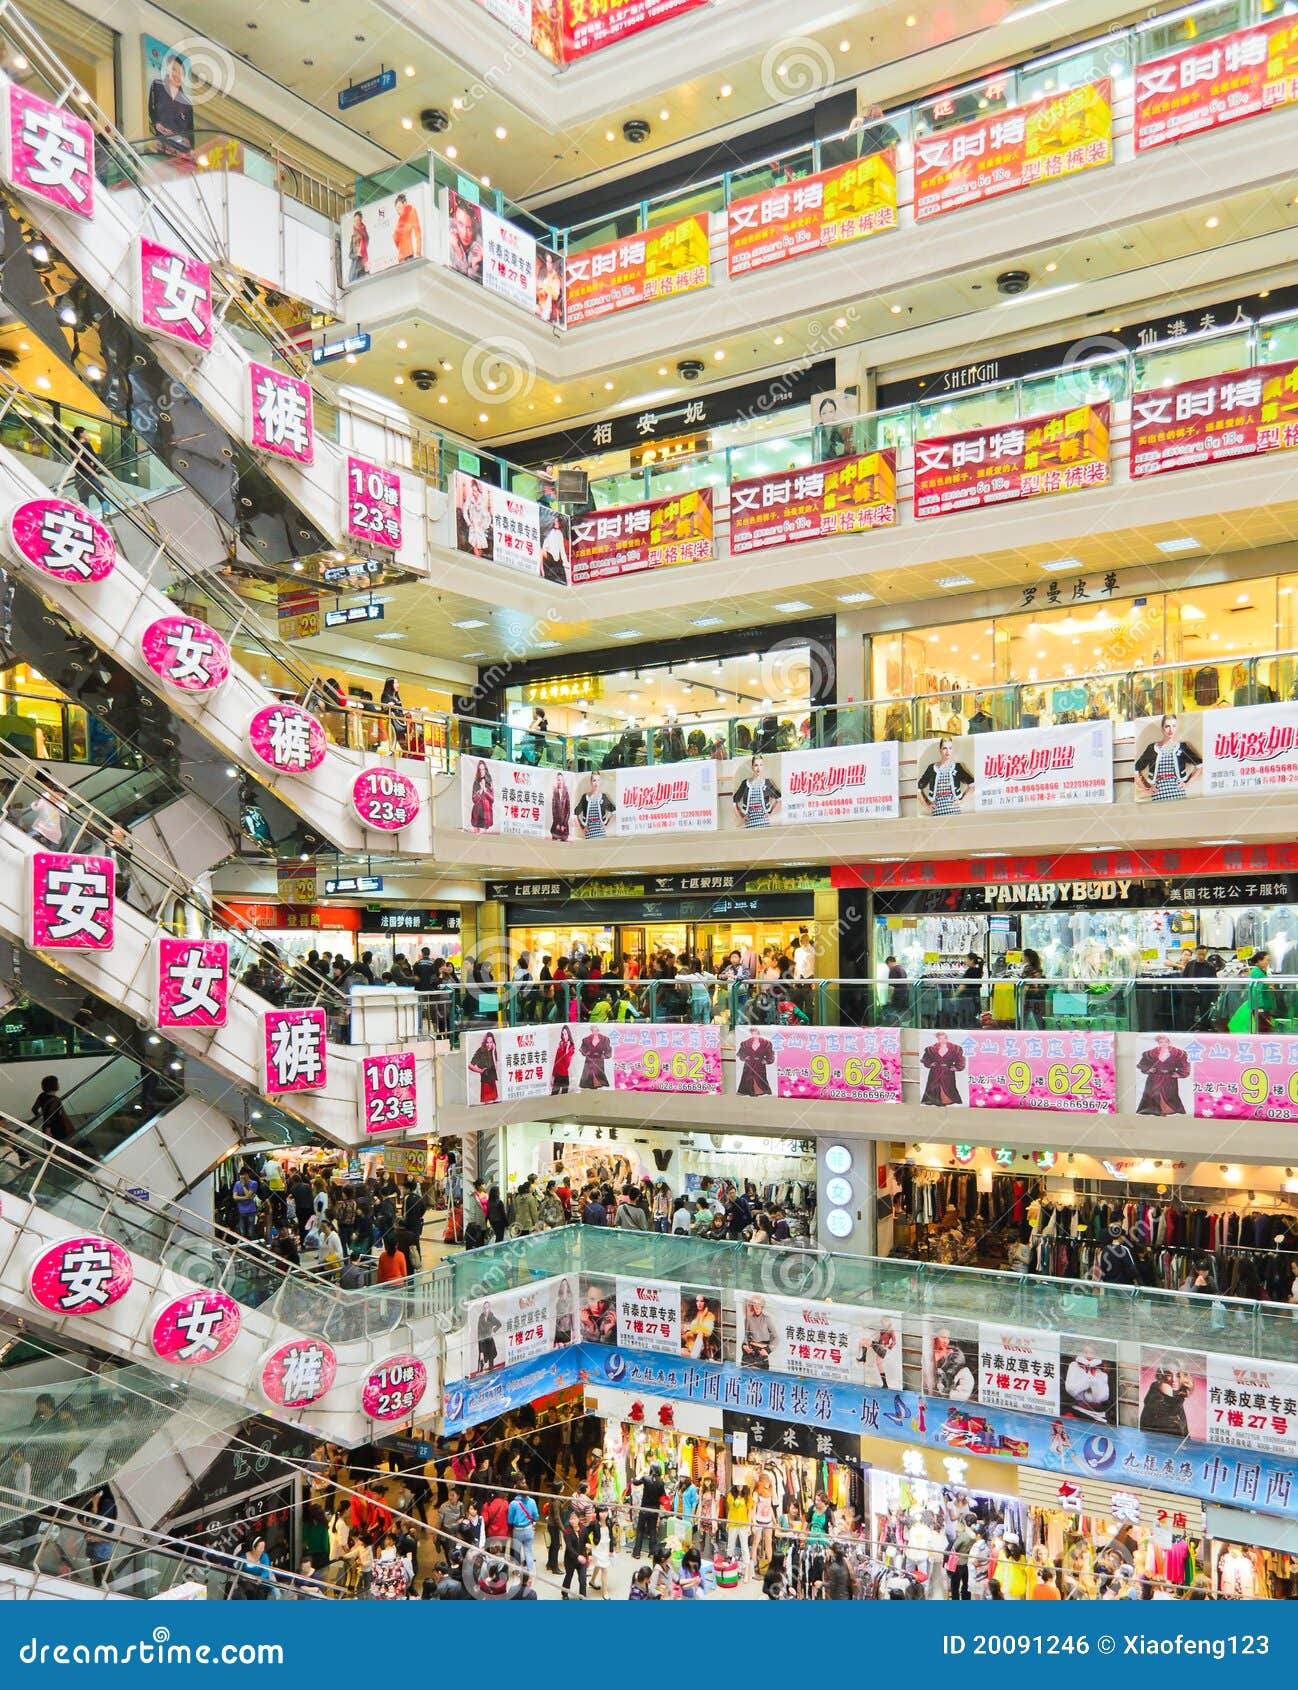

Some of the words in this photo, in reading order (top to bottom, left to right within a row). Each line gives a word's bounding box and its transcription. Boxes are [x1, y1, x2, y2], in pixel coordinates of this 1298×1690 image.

[1137, 34, 1268, 104] 文时特
[23, 108, 88, 203] 安
[915, 115, 1025, 175] 文时特
[1021, 139, 1108, 184] 型格裤装
[729, 182, 823, 235] 文时特
[820, 206, 894, 245] 型格裤装
[490, 259, 527, 289] 7楼27号
[565, 241, 645, 287] 文时特
[152, 257, 206, 336] 女
[643, 265, 707, 300] 型格裤装
[258, 378, 310, 454] 裤
[1132, 378, 1262, 430] 文时特
[916, 429, 1025, 475] 文时特
[351, 467, 400, 507] 10楼
[732, 473, 824, 514] 文时特
[1020, 461, 1106, 497] 型格裤装
[351, 501, 401, 540] 23号
[571, 509, 650, 546] 文时特
[820, 503, 894, 535] 型格裤装
[41, 510, 96, 578] 安
[496, 532, 534, 556] 7楼27号
[648, 538, 712, 568] 型格裤装
[1020, 572, 1120, 608] 罗曼皮草
[167, 624, 213, 684] 女
[269, 711, 310, 768] 裤
[1215, 726, 1298, 762] 诚邀加
[790, 764, 867, 796] 诚邀加盟
[985, 746, 1075, 781] 诚邀加盟
[366, 774, 406, 798] 10楼
[624, 781, 689, 810] 诚邀加盟
[368, 800, 408, 823] 23号
[504, 806, 540, 821] 7楼27号
[46, 863, 109, 941] 安
[984, 880, 1131, 904] PANARYBODY
[1169, 883, 1289, 902] 美国花花公子服饰
[169, 949, 223, 1019] 女
[271, 1018, 322, 1085] 裤
[366, 1063, 413, 1090] 10楼
[508, 1066, 543, 1082] 7楼27号
[369, 1096, 416, 1123] 23号
[61, 1246, 113, 1308] 安
[177, 1301, 223, 1359] 女
[508, 1324, 543, 1346] 7楼27号
[625, 1319, 670, 1338] 7楼27号
[786, 1325, 848, 1348] 肯泰皮草专卖
[789, 1344, 842, 1364] 7楼27号
[981, 1352, 1055, 1379] 肯泰皮草专卖
[283, 1347, 323, 1400] 裤
[377, 1365, 416, 1387] 10楼
[985, 1372, 1047, 1396] 7楼27号
[377, 1393, 414, 1414] 23号
[683, 1367, 880, 1431] 中国西部服装第一城
[1209, 1386, 1297, 1416] 肯泰皮草专卖
[1214, 1409, 1288, 1435] 7楼27号
[1202, 1456, 1294, 1507] 中国西
